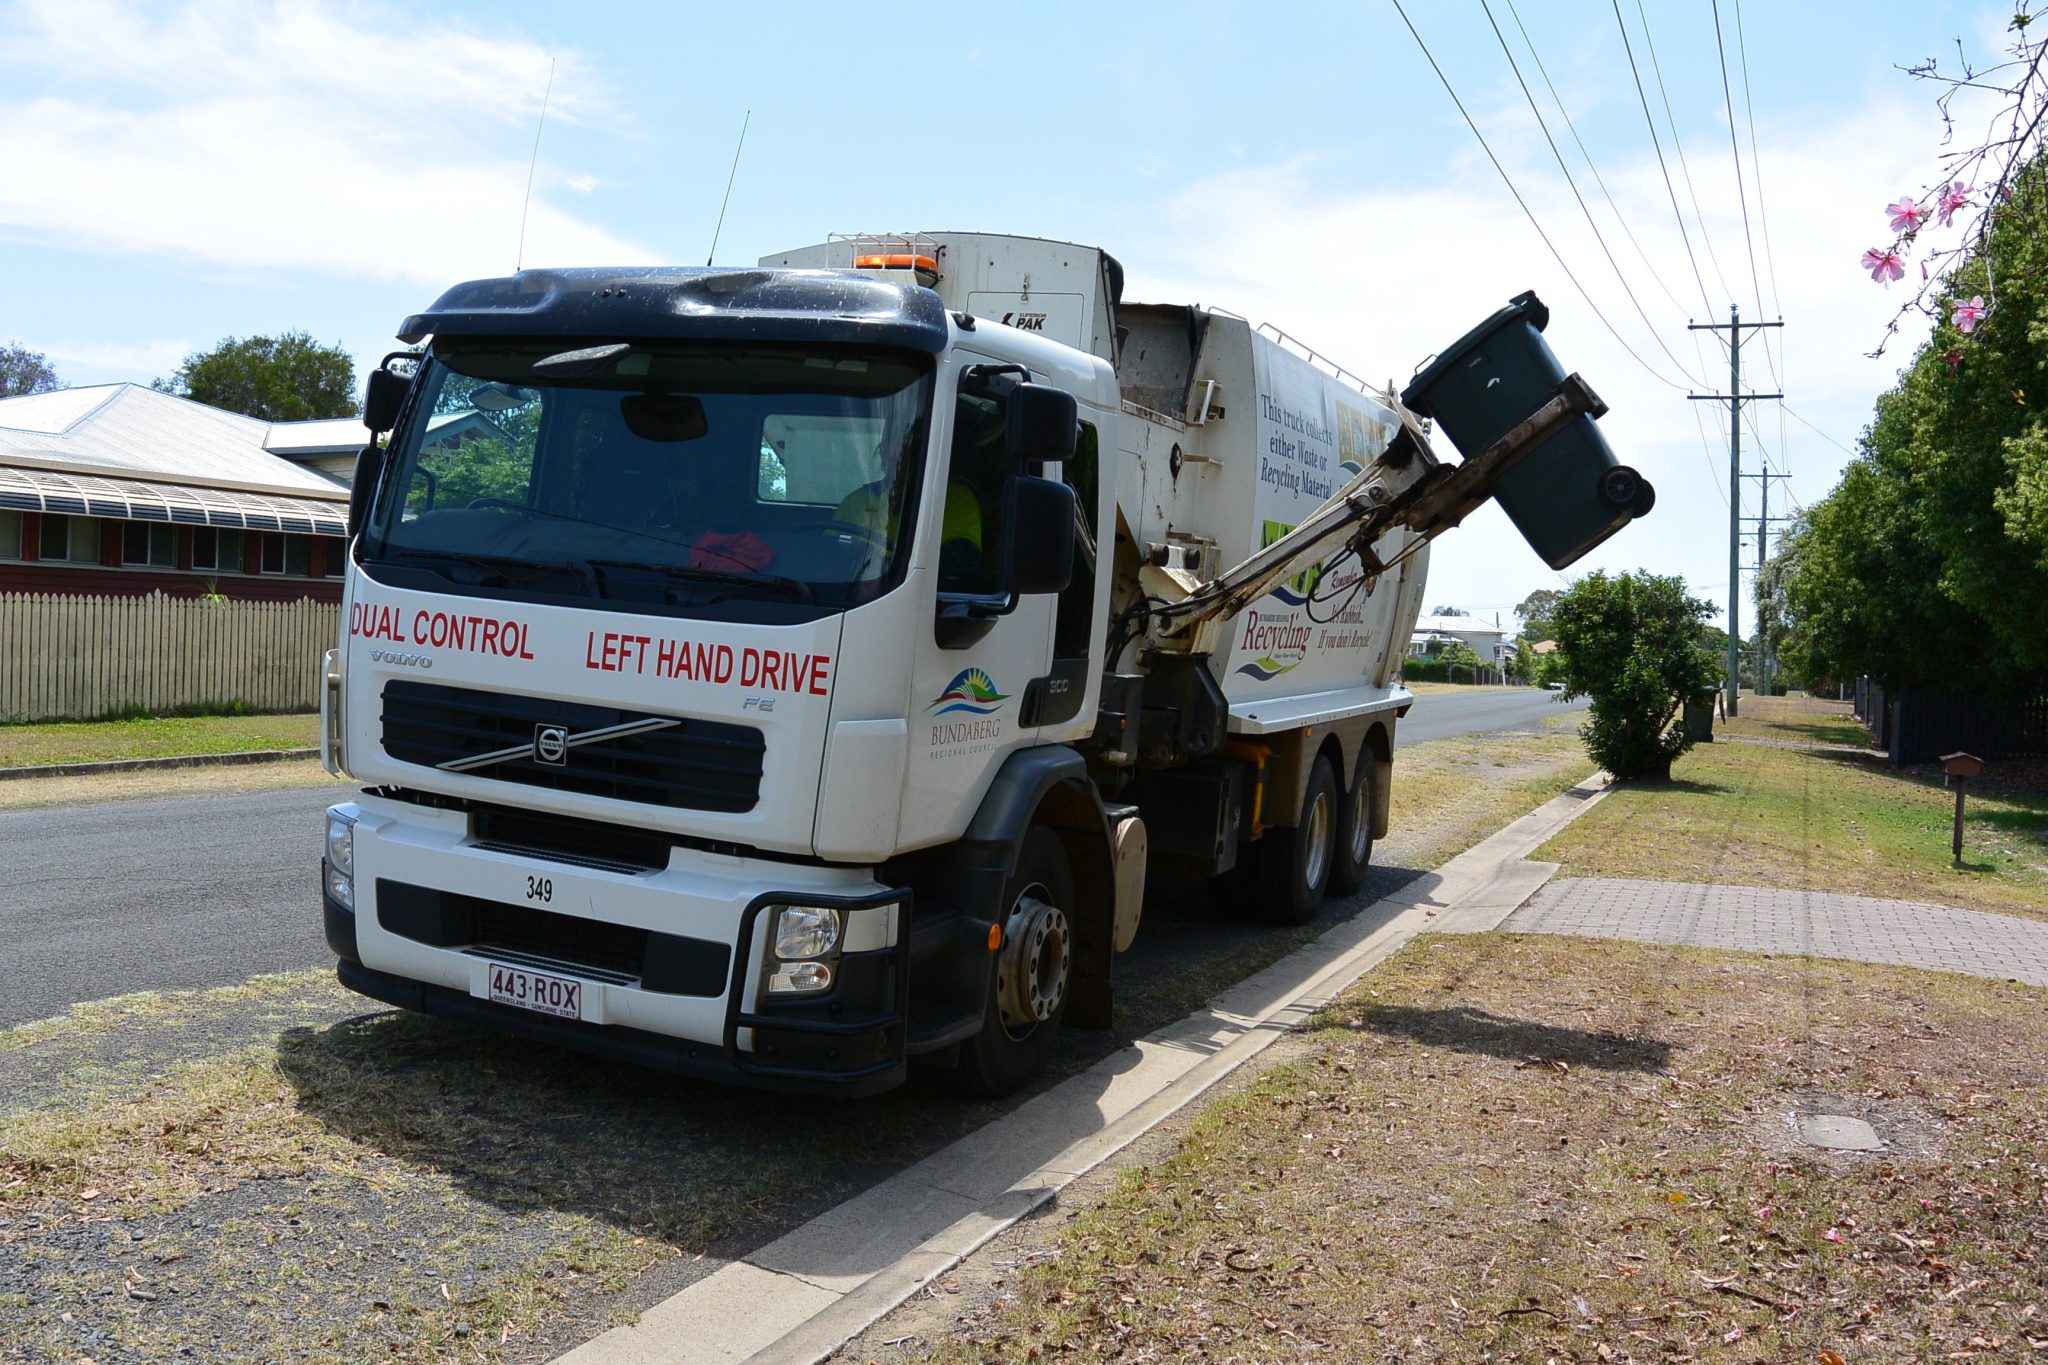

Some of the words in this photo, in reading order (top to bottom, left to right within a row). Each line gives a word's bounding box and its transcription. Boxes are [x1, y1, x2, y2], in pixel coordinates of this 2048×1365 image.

[1016, 318, 1045, 330] PAK
[1261, 394, 1282, 424] This
[1284, 409, 1305, 434] truck
[1306, 418, 1333, 446] collects
[1270, 429, 1295, 460] either
[1298, 440, 1318, 468] Waste
[1319, 455, 1327, 471] or
[1261, 457, 1300, 499] Recycling
[1301, 470, 1332, 500] Material
[351, 601, 405, 642] DUAL
[413, 609, 534, 660] CONTROL
[1241, 610, 1312, 662] Recycling
[369, 648, 433, 669] VOLVO
[586, 631, 651, 673] LEFT
[657, 638, 733, 684] HAND
[740, 648, 831, 695] DRIVE
[743, 695, 776, 712] FE
[931, 718, 1000, 745] BUNDABERG
[930, 747, 966, 760] REGIONAL
[969, 743, 997, 754] COUNCIL
[526, 875, 552, 902] 349
[493, 994, 527, 1007] QUEENSLAND
[560, 1009, 576, 1019] STATE
